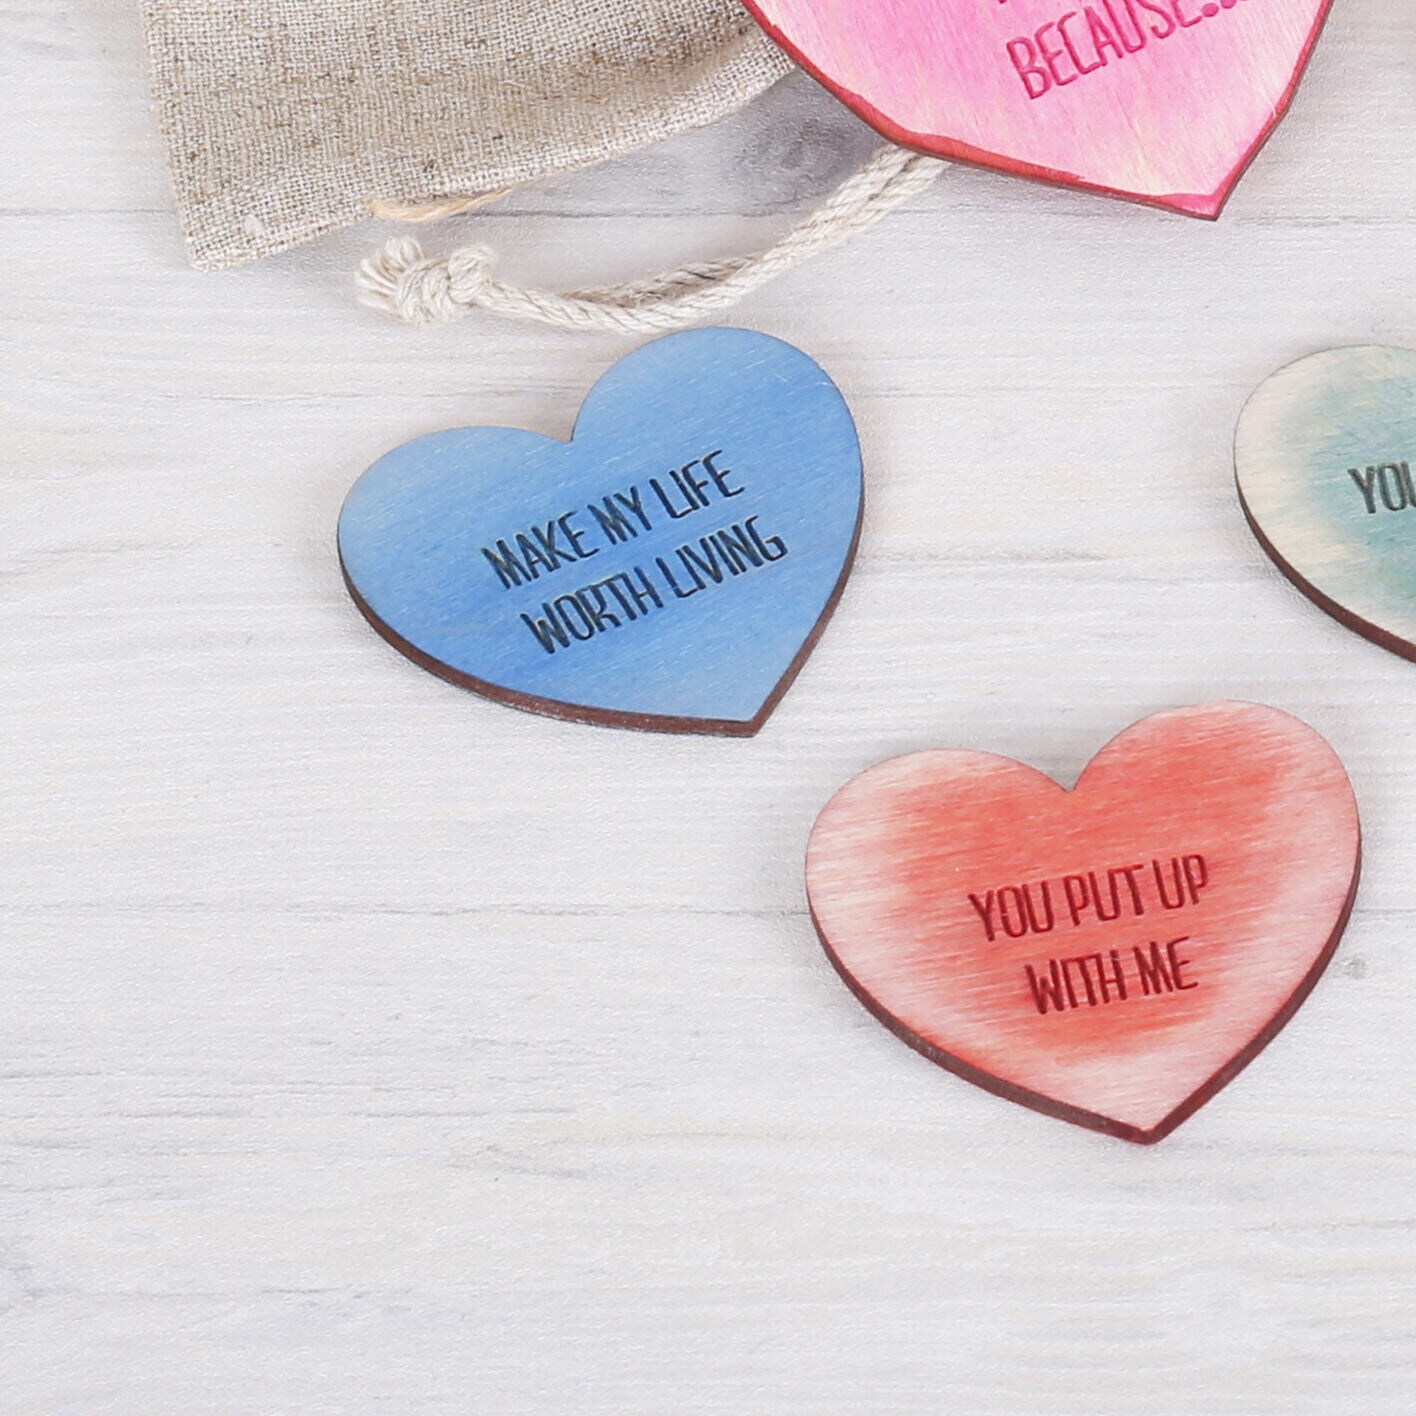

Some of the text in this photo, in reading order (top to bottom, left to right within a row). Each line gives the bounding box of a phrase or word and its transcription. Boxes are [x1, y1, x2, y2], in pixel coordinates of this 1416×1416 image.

[481, 449, 745, 589] MAKE MY LIFE
[520, 515, 788, 654] WORTH LIVING
[968, 854, 1209, 942] YOU PUT UP
[1024, 936, 1199, 1015] WITH ME
